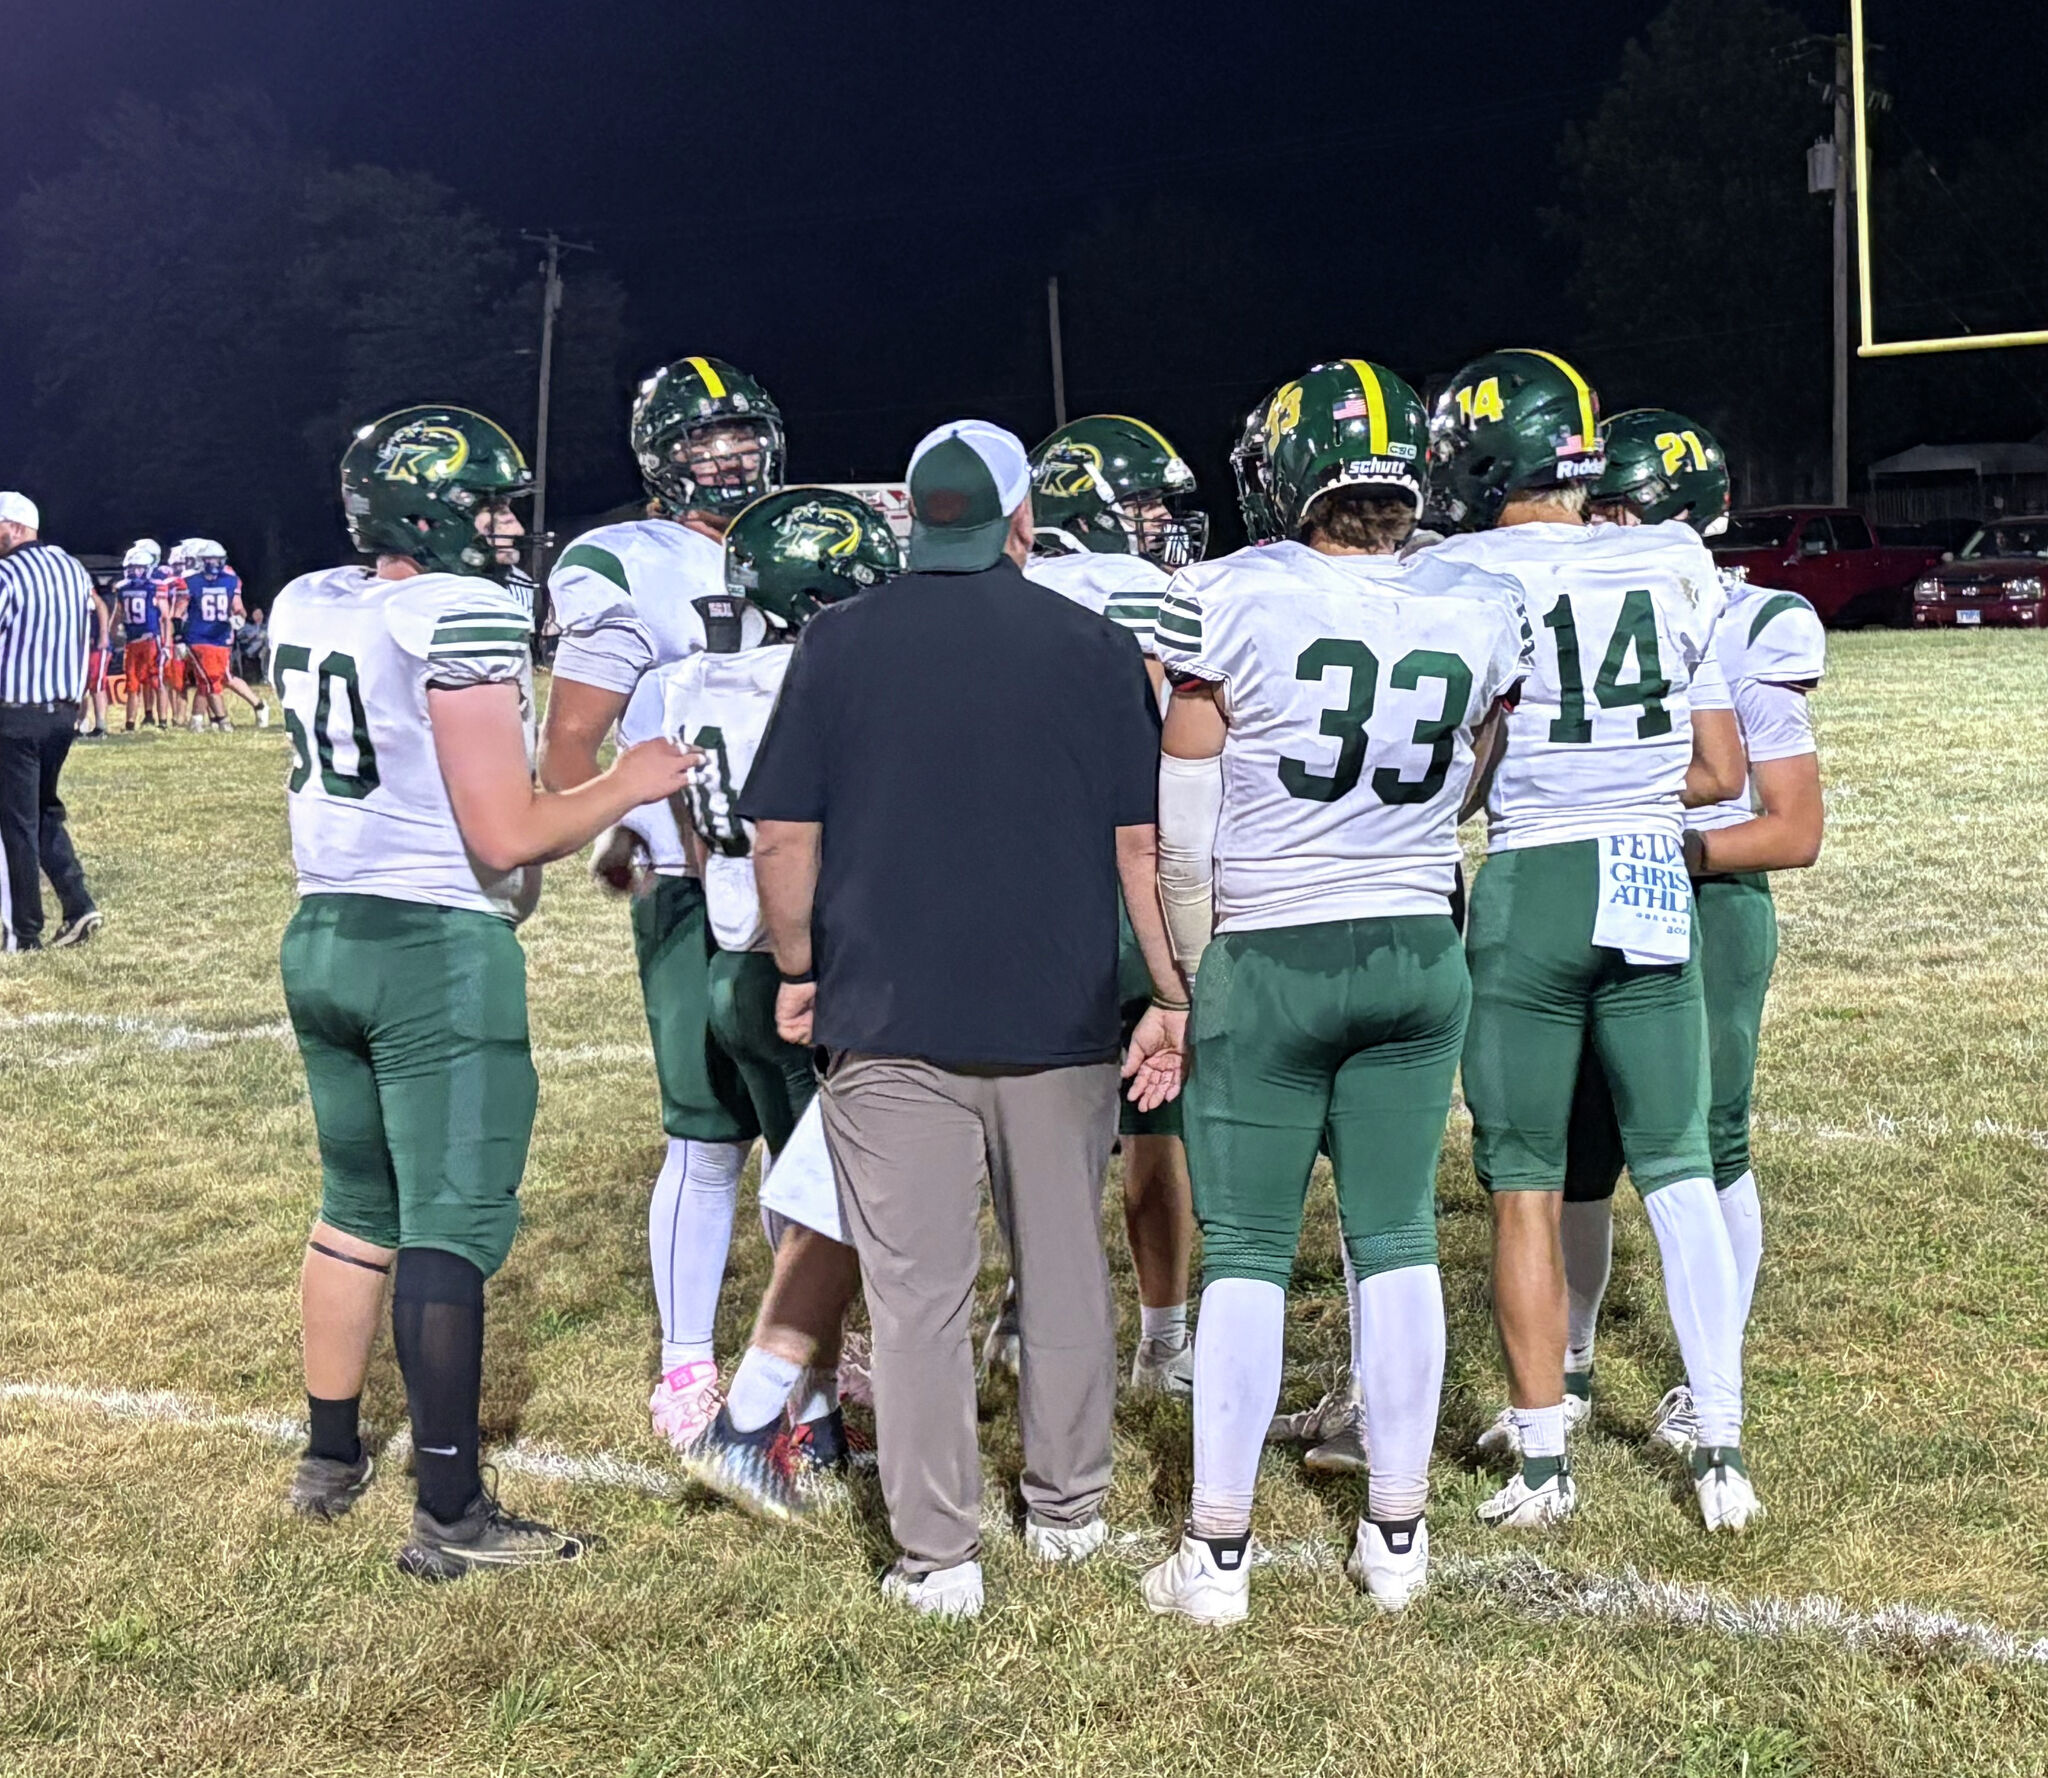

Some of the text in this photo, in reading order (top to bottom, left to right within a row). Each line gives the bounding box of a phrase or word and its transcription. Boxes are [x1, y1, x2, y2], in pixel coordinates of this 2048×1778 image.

[1456, 377, 1504, 426] 14
[1655, 431, 1707, 476] 21
[124, 598, 146, 624] 19
[201, 595, 228, 621] 69
[1543, 590, 1672, 743] 14
[273, 643, 381, 800] 50
[1278, 638, 1474, 805] 33
